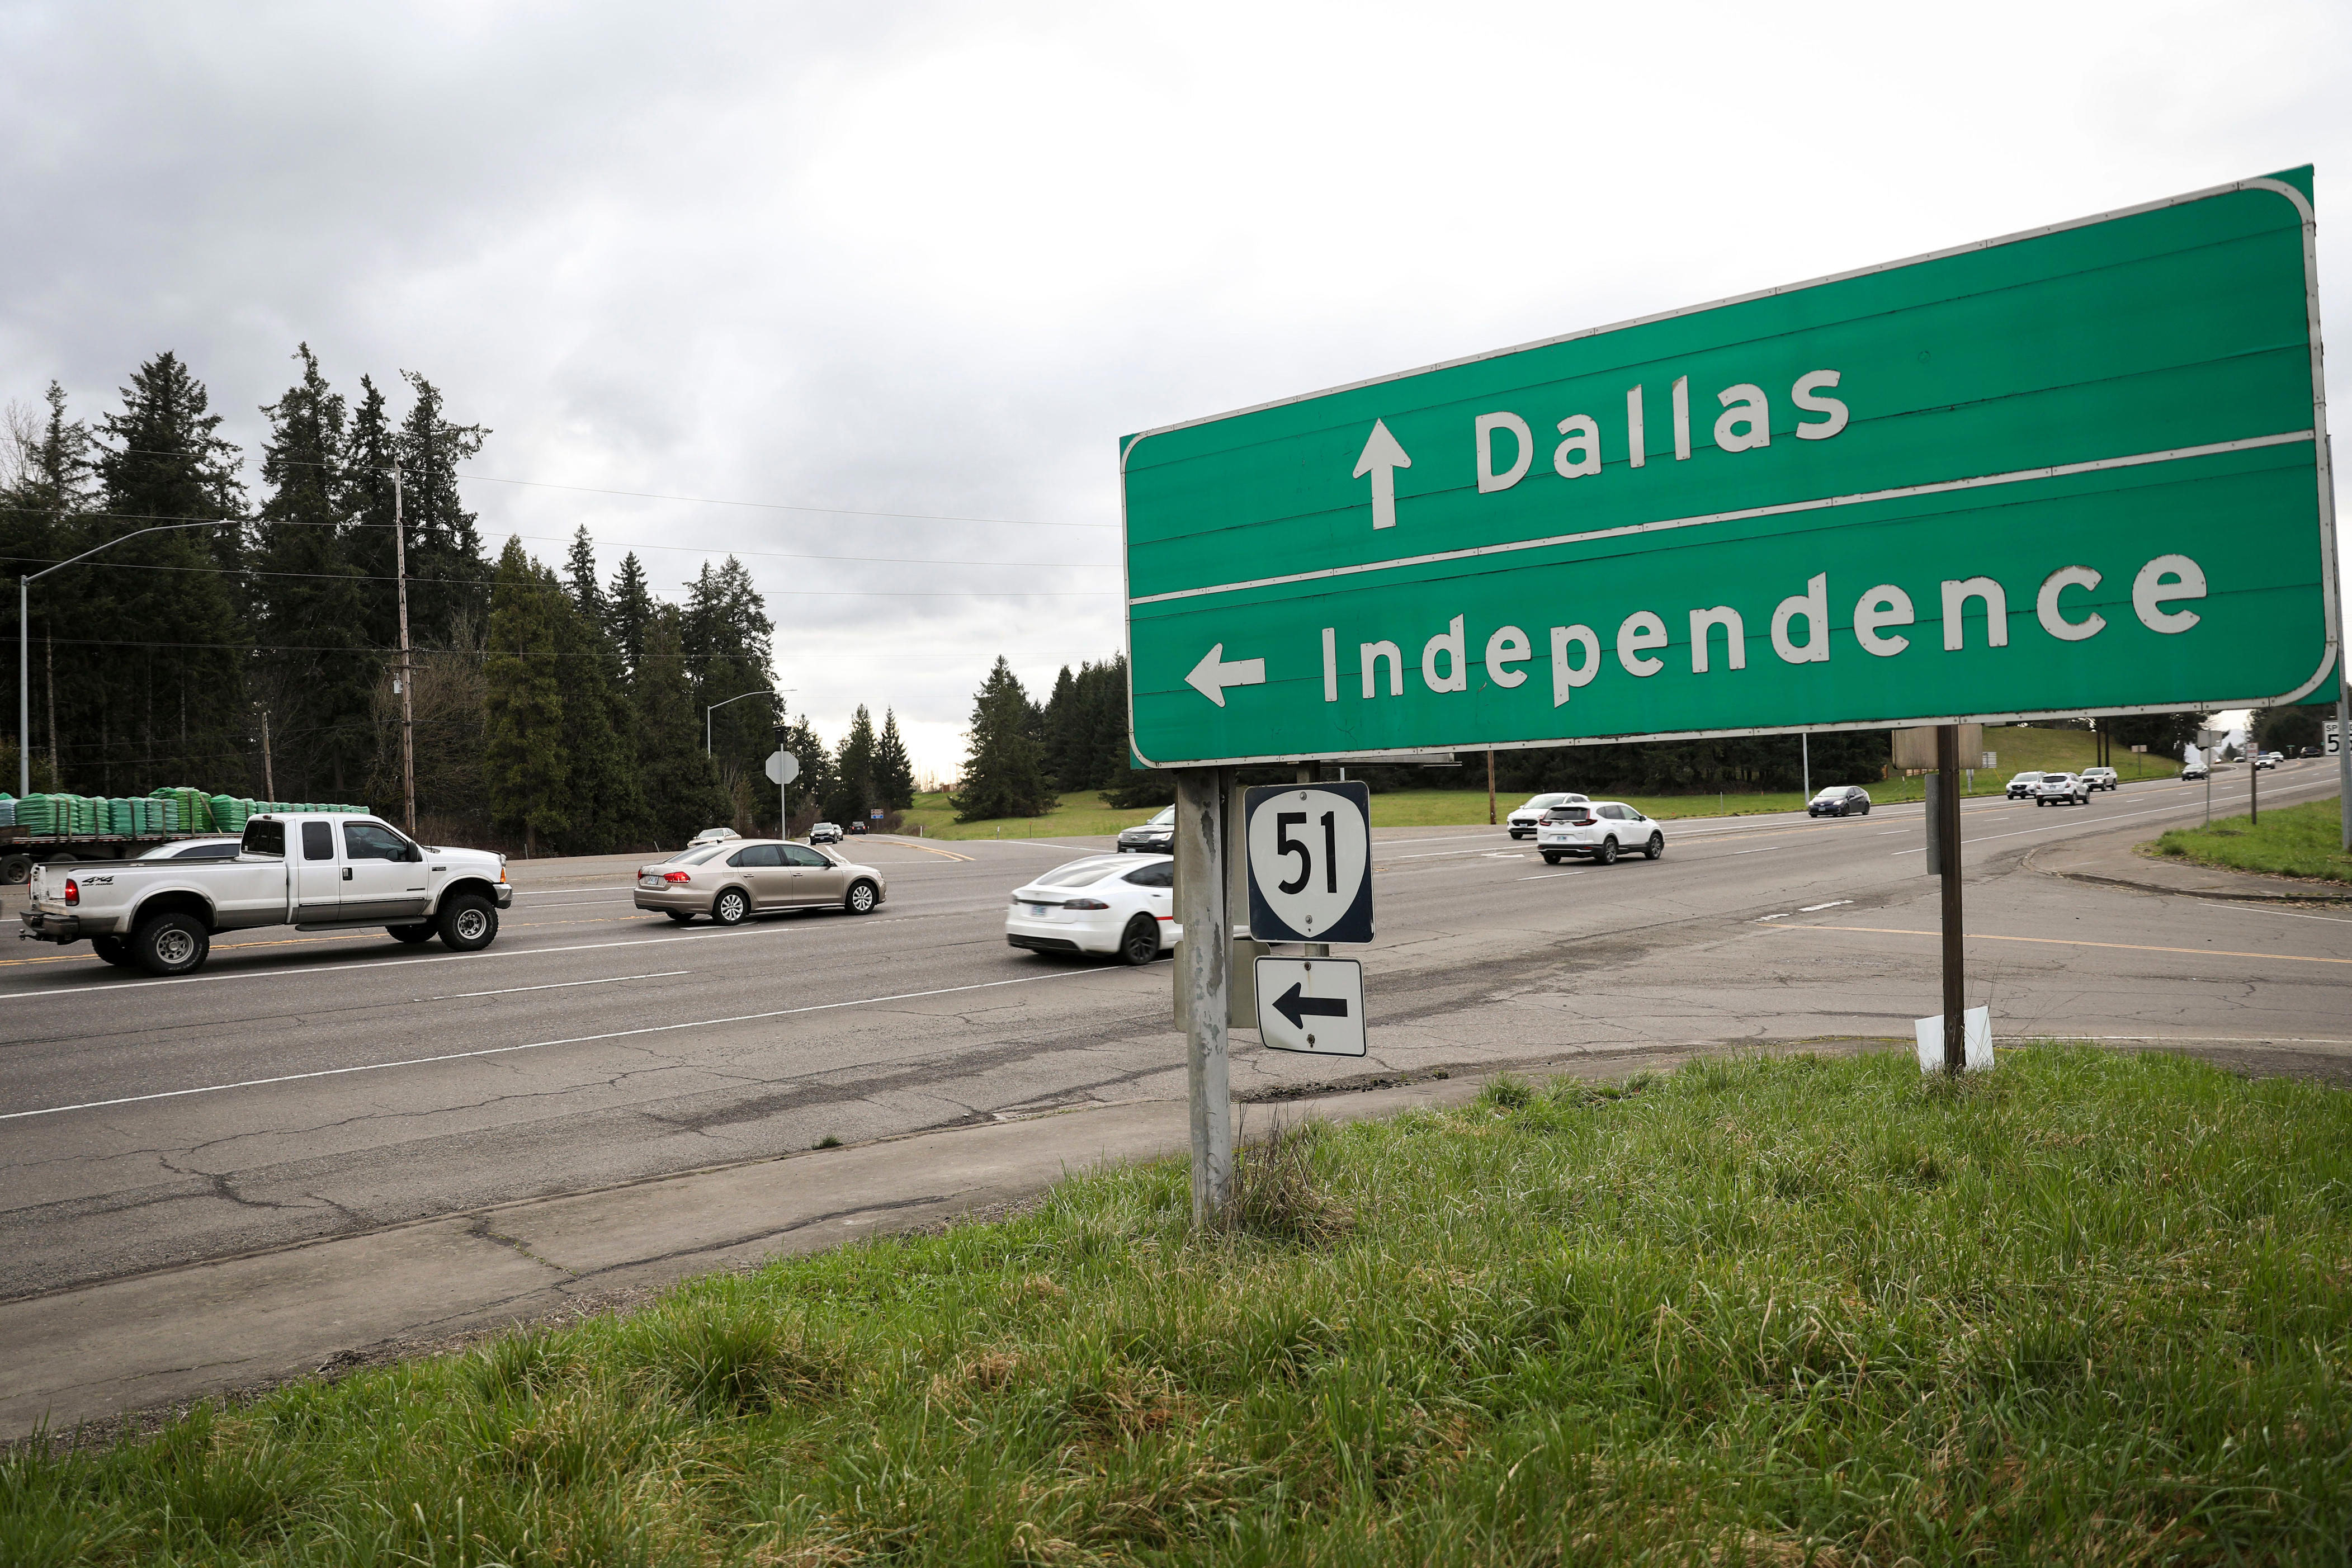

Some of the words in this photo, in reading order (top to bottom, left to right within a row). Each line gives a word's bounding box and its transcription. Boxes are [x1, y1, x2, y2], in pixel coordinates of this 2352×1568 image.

[1475, 369, 1849, 494] Dallas
[1322, 554, 2207, 708] Independence
[1277, 811, 1337, 895] 51
